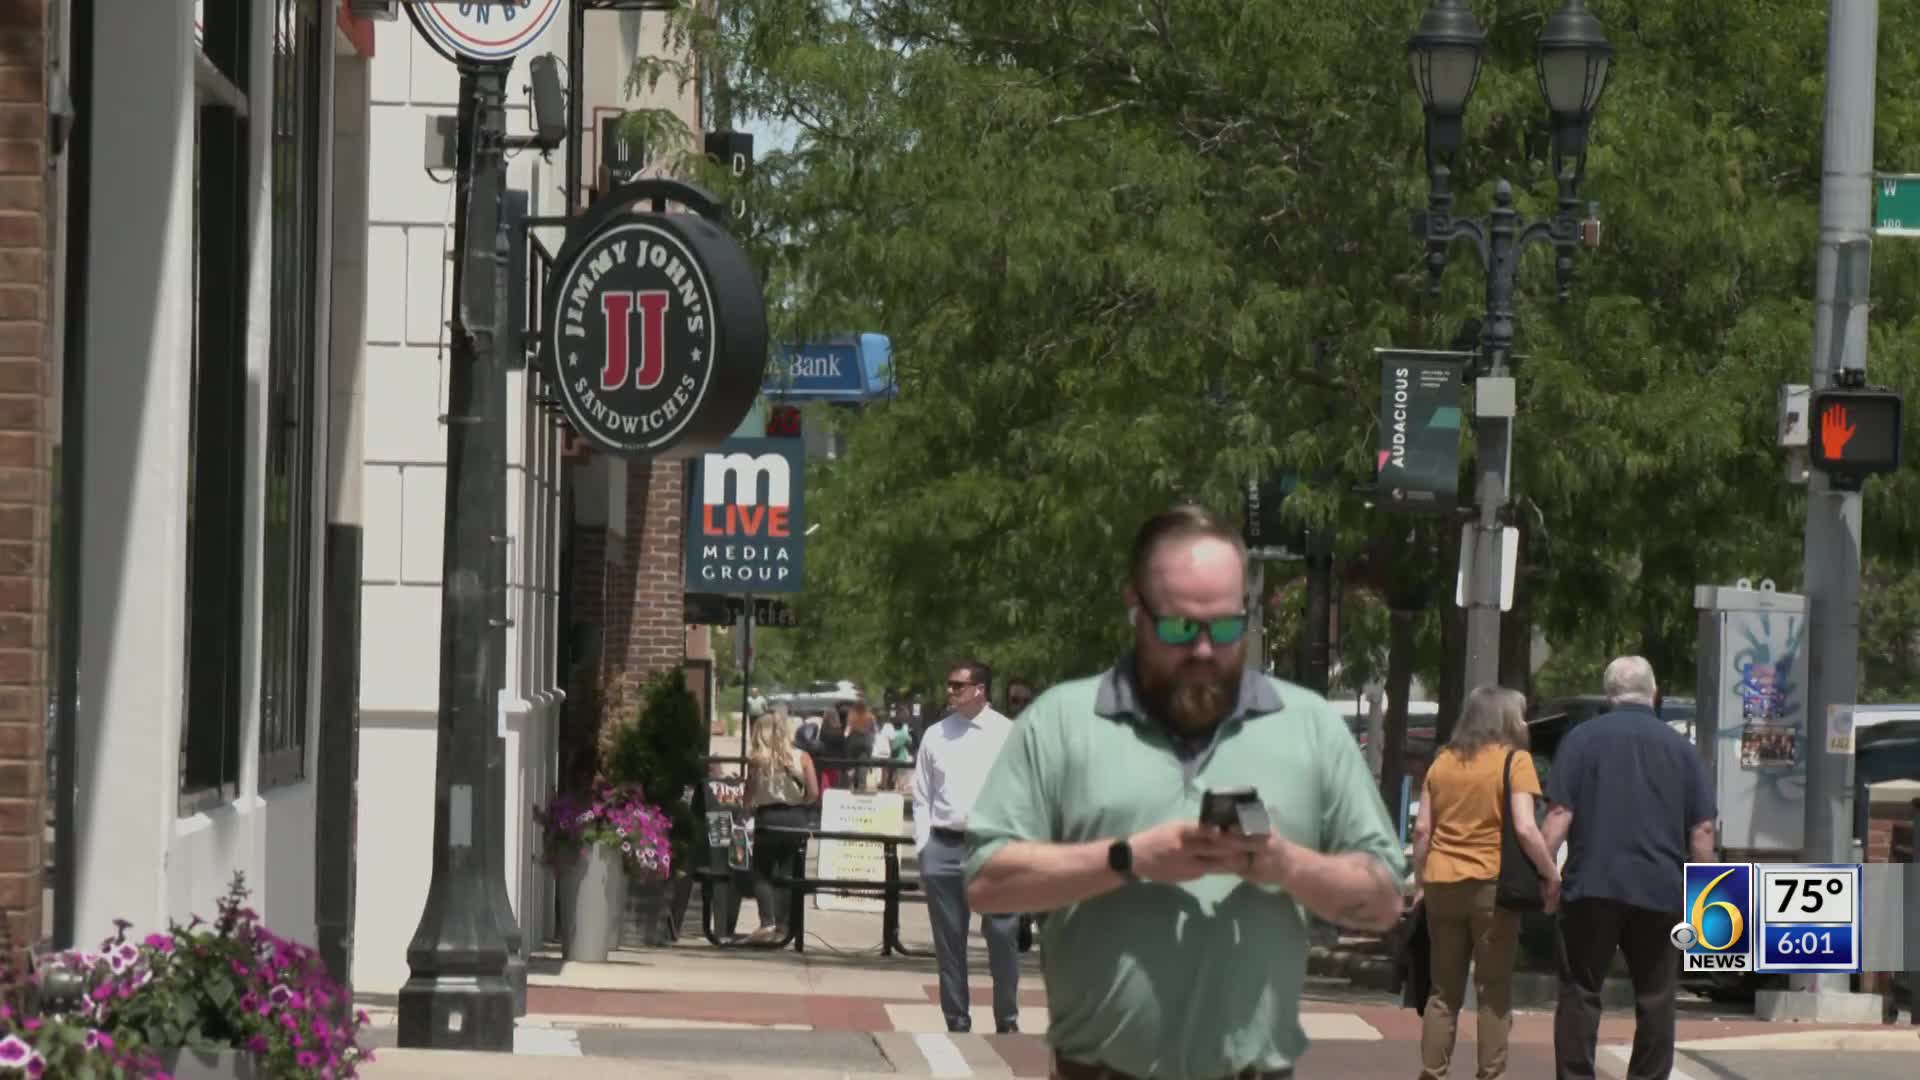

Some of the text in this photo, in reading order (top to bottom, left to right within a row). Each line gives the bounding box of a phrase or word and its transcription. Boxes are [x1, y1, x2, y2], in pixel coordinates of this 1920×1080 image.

[1883, 180, 1897, 197] W
[565, 240, 704, 338] JIMMY JOHN'S
[600, 291, 669, 390] JJ
[790, 353, 841, 377] Bank
[574, 373, 696, 435] SANDWICHES
[1391, 367, 1409, 468] AUDACIOUS
[703, 503, 791, 537] LIVE
[703, 545, 790, 561] MEDIA
[702, 565, 790, 581] GROUP
